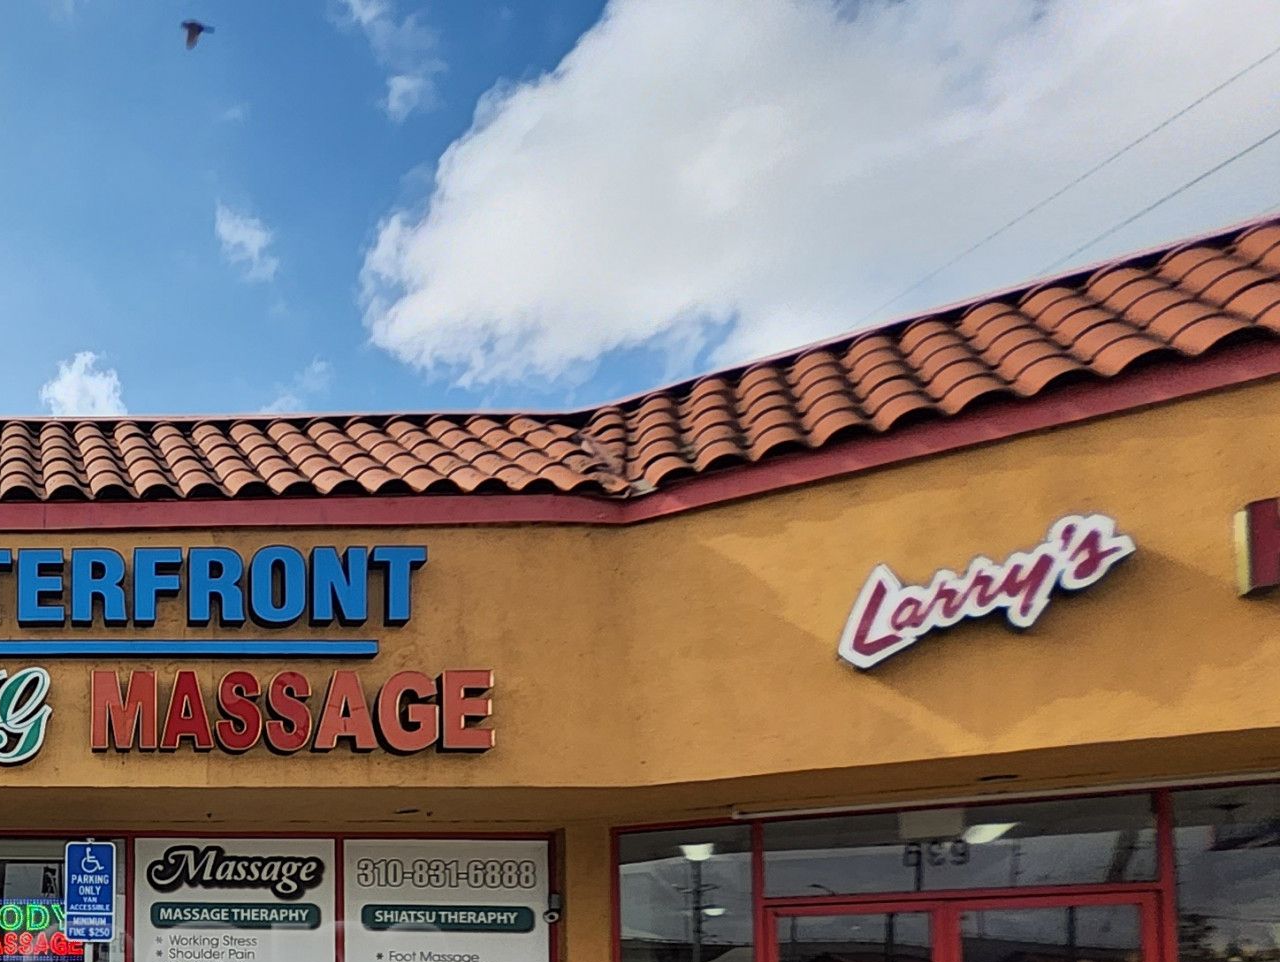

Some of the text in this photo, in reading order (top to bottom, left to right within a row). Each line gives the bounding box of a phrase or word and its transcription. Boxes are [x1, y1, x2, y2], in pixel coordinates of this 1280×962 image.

[846, 519, 1128, 660] Larry's
[91, 669, 496, 756] MASSAGE
[150, 848, 319, 895] Massage
[357, 858, 536, 889] 310-831-6888
[71, 874, 109, 884] PARKING
[79, 886, 101, 896] ONLY
[73, 917, 106, 925] MINIMUM
[159, 908, 309, 921] MASSAGE THERAPHY
[374, 910, 518, 924] SHIATSU THERAPHY
[69, 927, 109, 937] FINE $250
[169, 935, 257, 948] Working Stress
[169, 949, 255, 960] Shoulder Pain
[389, 951, 417, 962] Foot
